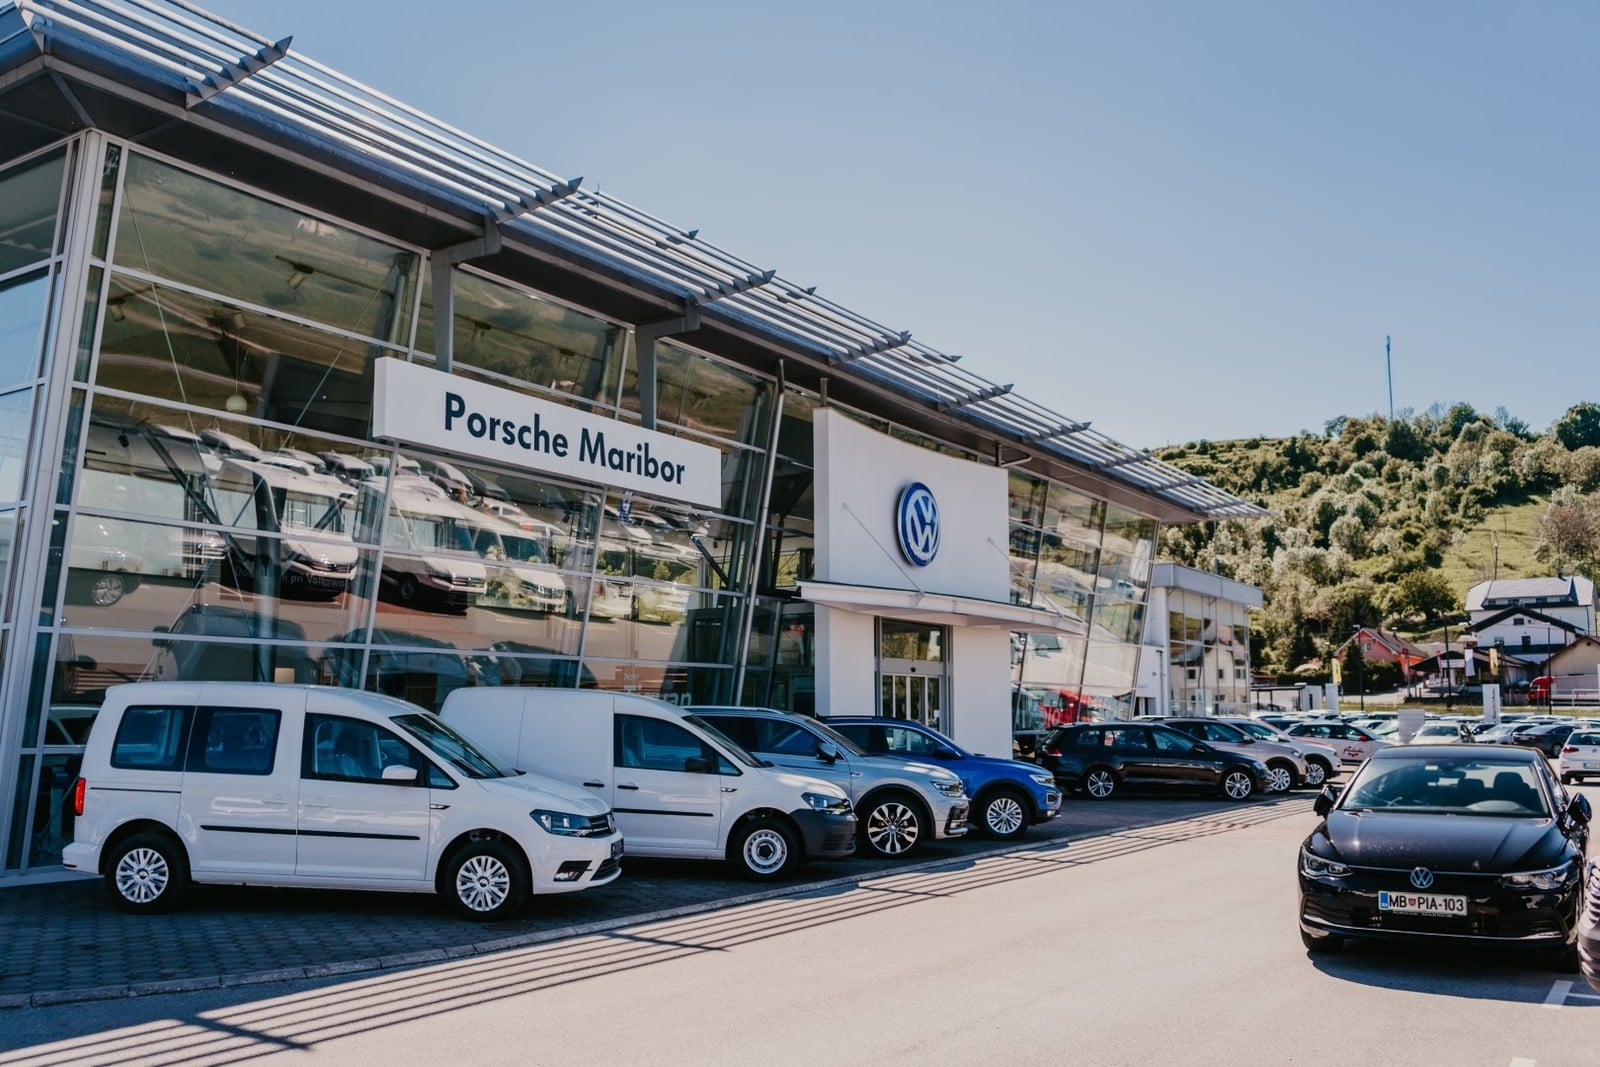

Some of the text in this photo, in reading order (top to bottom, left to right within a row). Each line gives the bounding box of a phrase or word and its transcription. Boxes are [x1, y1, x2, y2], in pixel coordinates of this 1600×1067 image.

[445, 391, 686, 486] Porsche Maribor
[1411, 867, 1433, 888] VW
[1389, 894, 1464, 912] MB PIA-103
